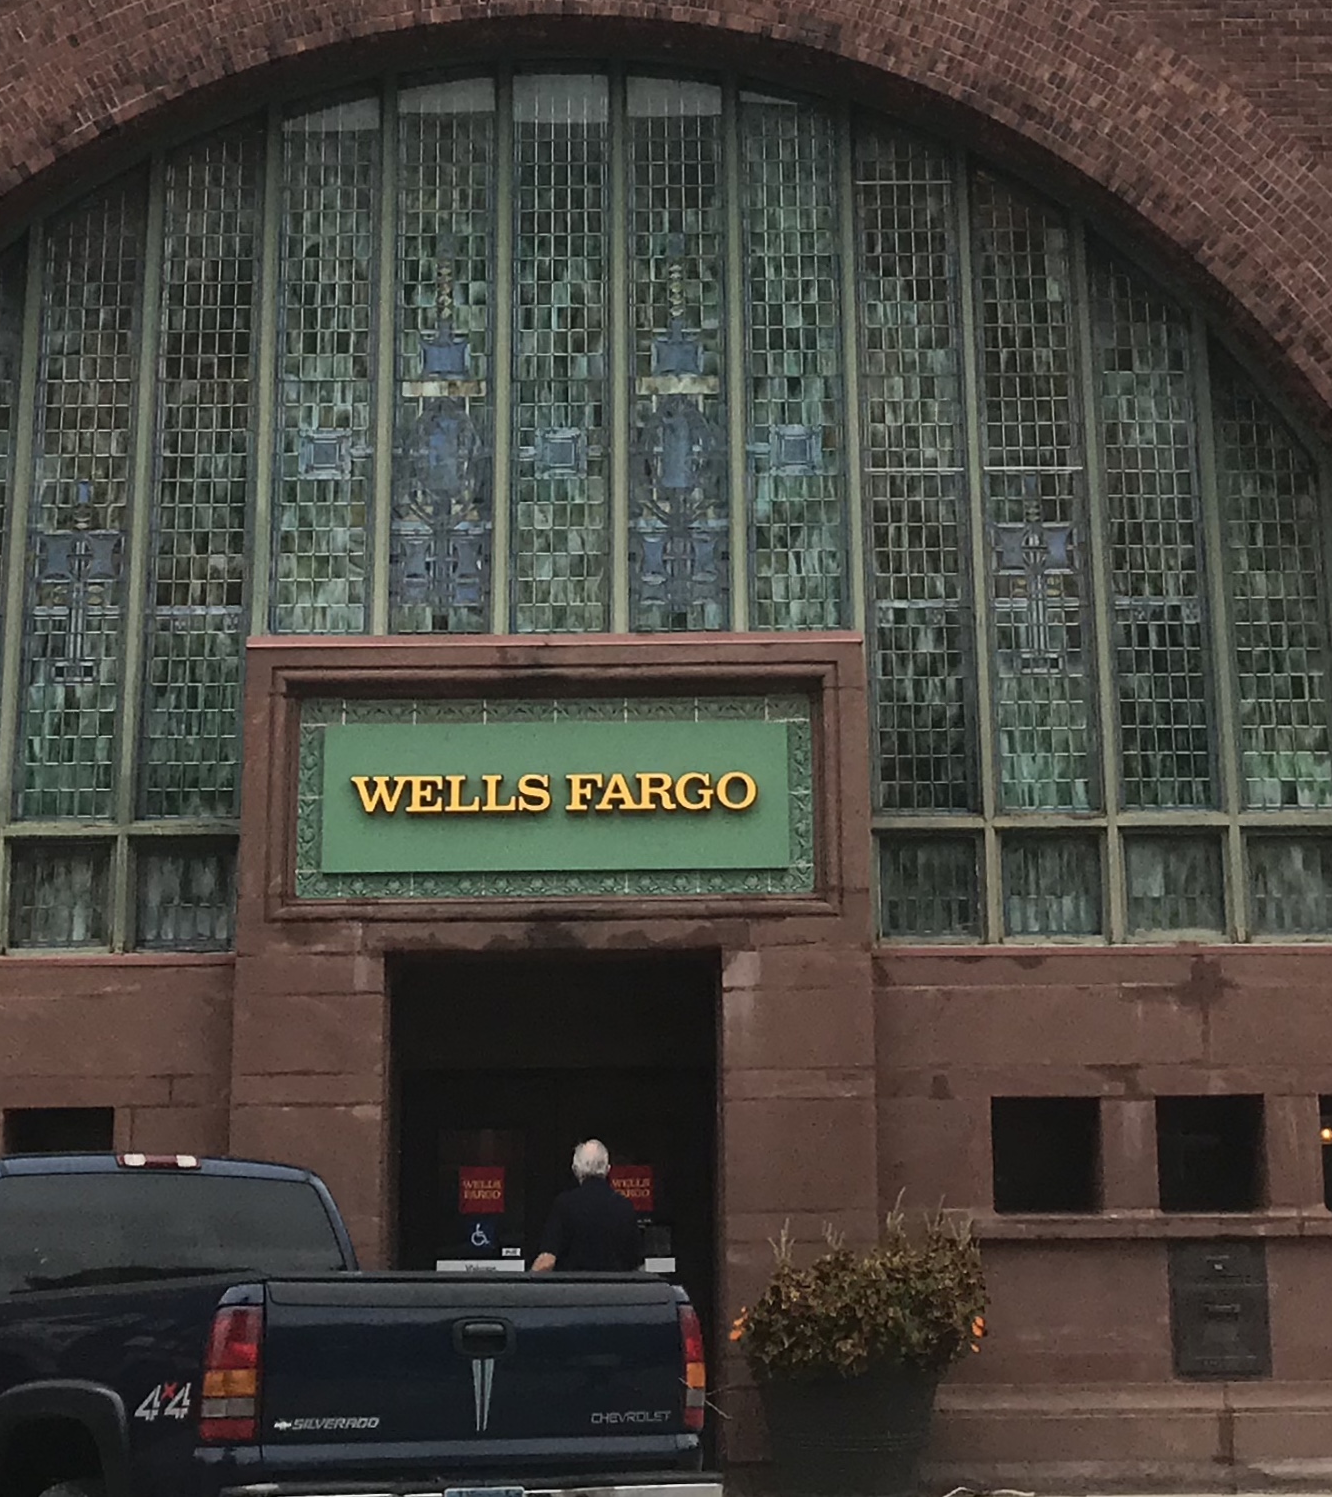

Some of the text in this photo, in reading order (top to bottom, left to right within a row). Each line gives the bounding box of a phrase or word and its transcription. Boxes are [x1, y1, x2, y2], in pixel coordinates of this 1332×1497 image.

[350, 771, 759, 813] WELLS FARGO
[462, 1180, 502, 1189] WELLS
[612, 1178, 651, 1188] WELLS
[463, 1189, 502, 1199] FARGO
[591, 1410, 672, 1424] CHEVROLET
[292, 1417, 380, 1430] SILVERADO
